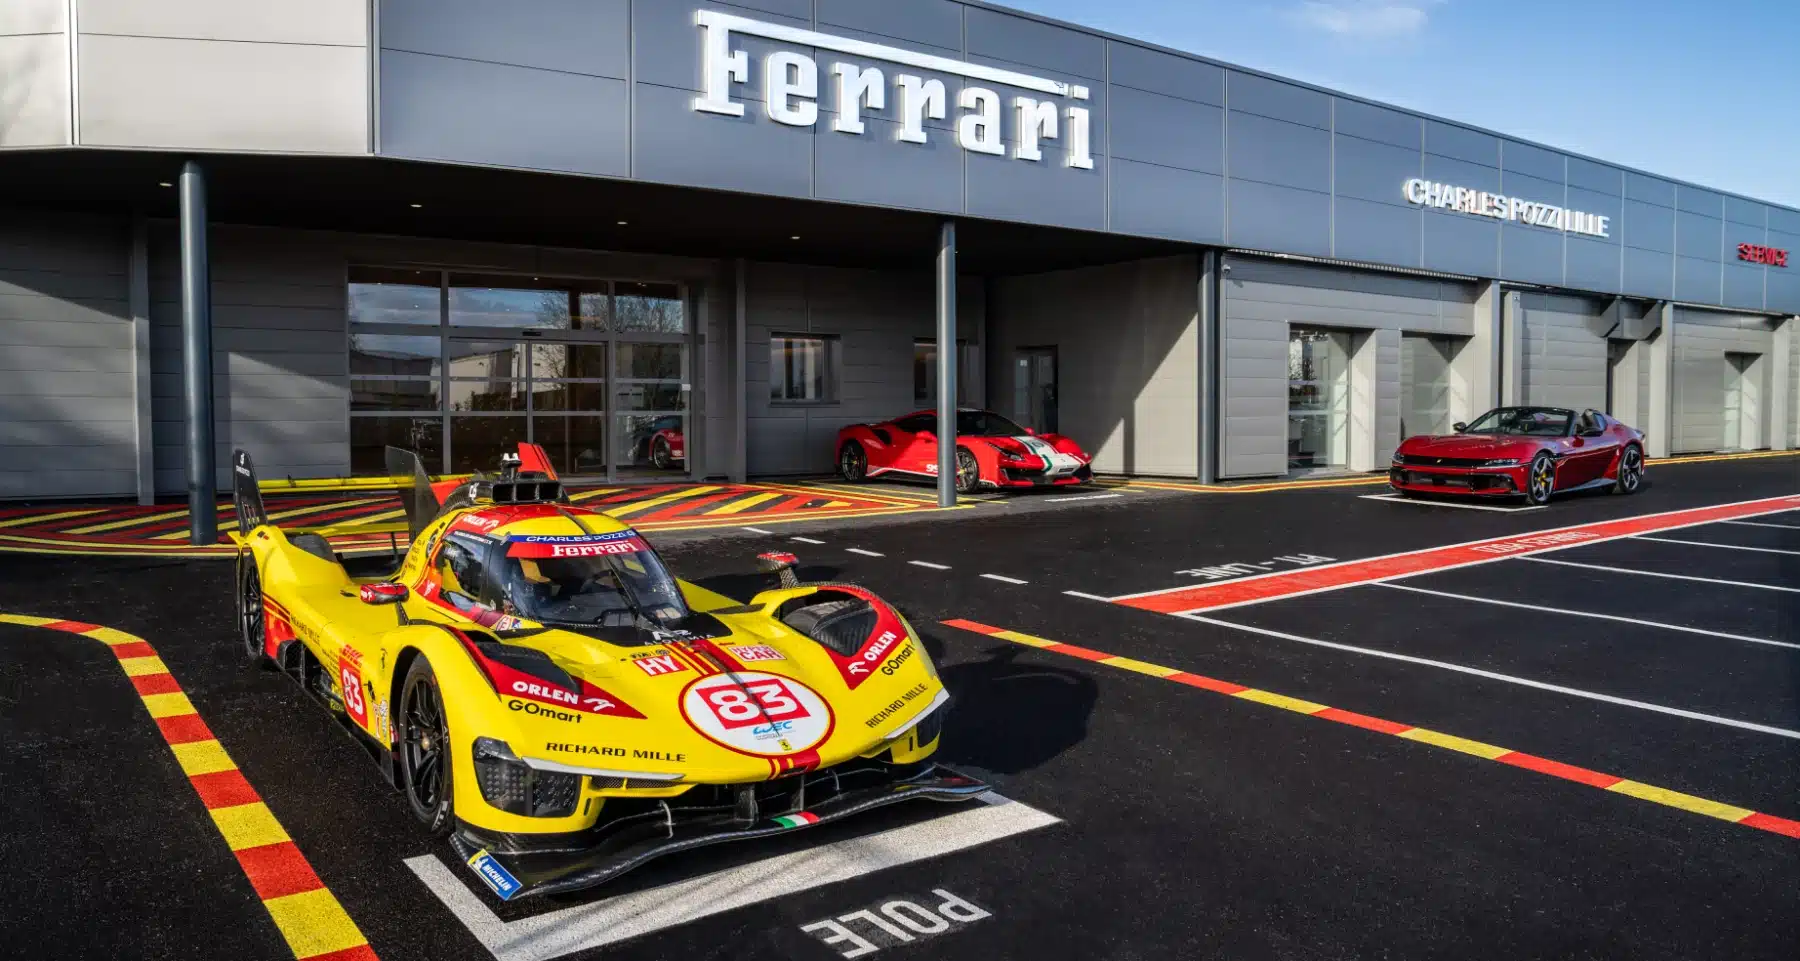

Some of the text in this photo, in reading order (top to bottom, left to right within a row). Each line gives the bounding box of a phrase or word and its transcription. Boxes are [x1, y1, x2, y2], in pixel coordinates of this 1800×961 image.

[693, 9, 1094, 170] Ferrari
[1405, 178, 1610, 238] CHARLES POZZI LILLE
[551, 540, 639, 557] Ferrari
[593, 532, 626, 541] POZZI
[1173, 562, 1274, 579] LANE
[739, 650, 783, 660] CAR
[863, 630, 897, 662] ORLEN
[635, 655, 680, 676] HY
[880, 643, 916, 677] GOmart
[342, 668, 364, 716] 83
[512, 680, 580, 705] ORLEN
[709, 683, 798, 721] 83
[865, 682, 929, 728] RICHARD MILLE
[507, 699, 583, 724] GOmart
[545, 742, 687, 763] RICHARD MILLE
[482, 864, 513, 891] MICHELIN
[800, 888, 992, 960] POLE
